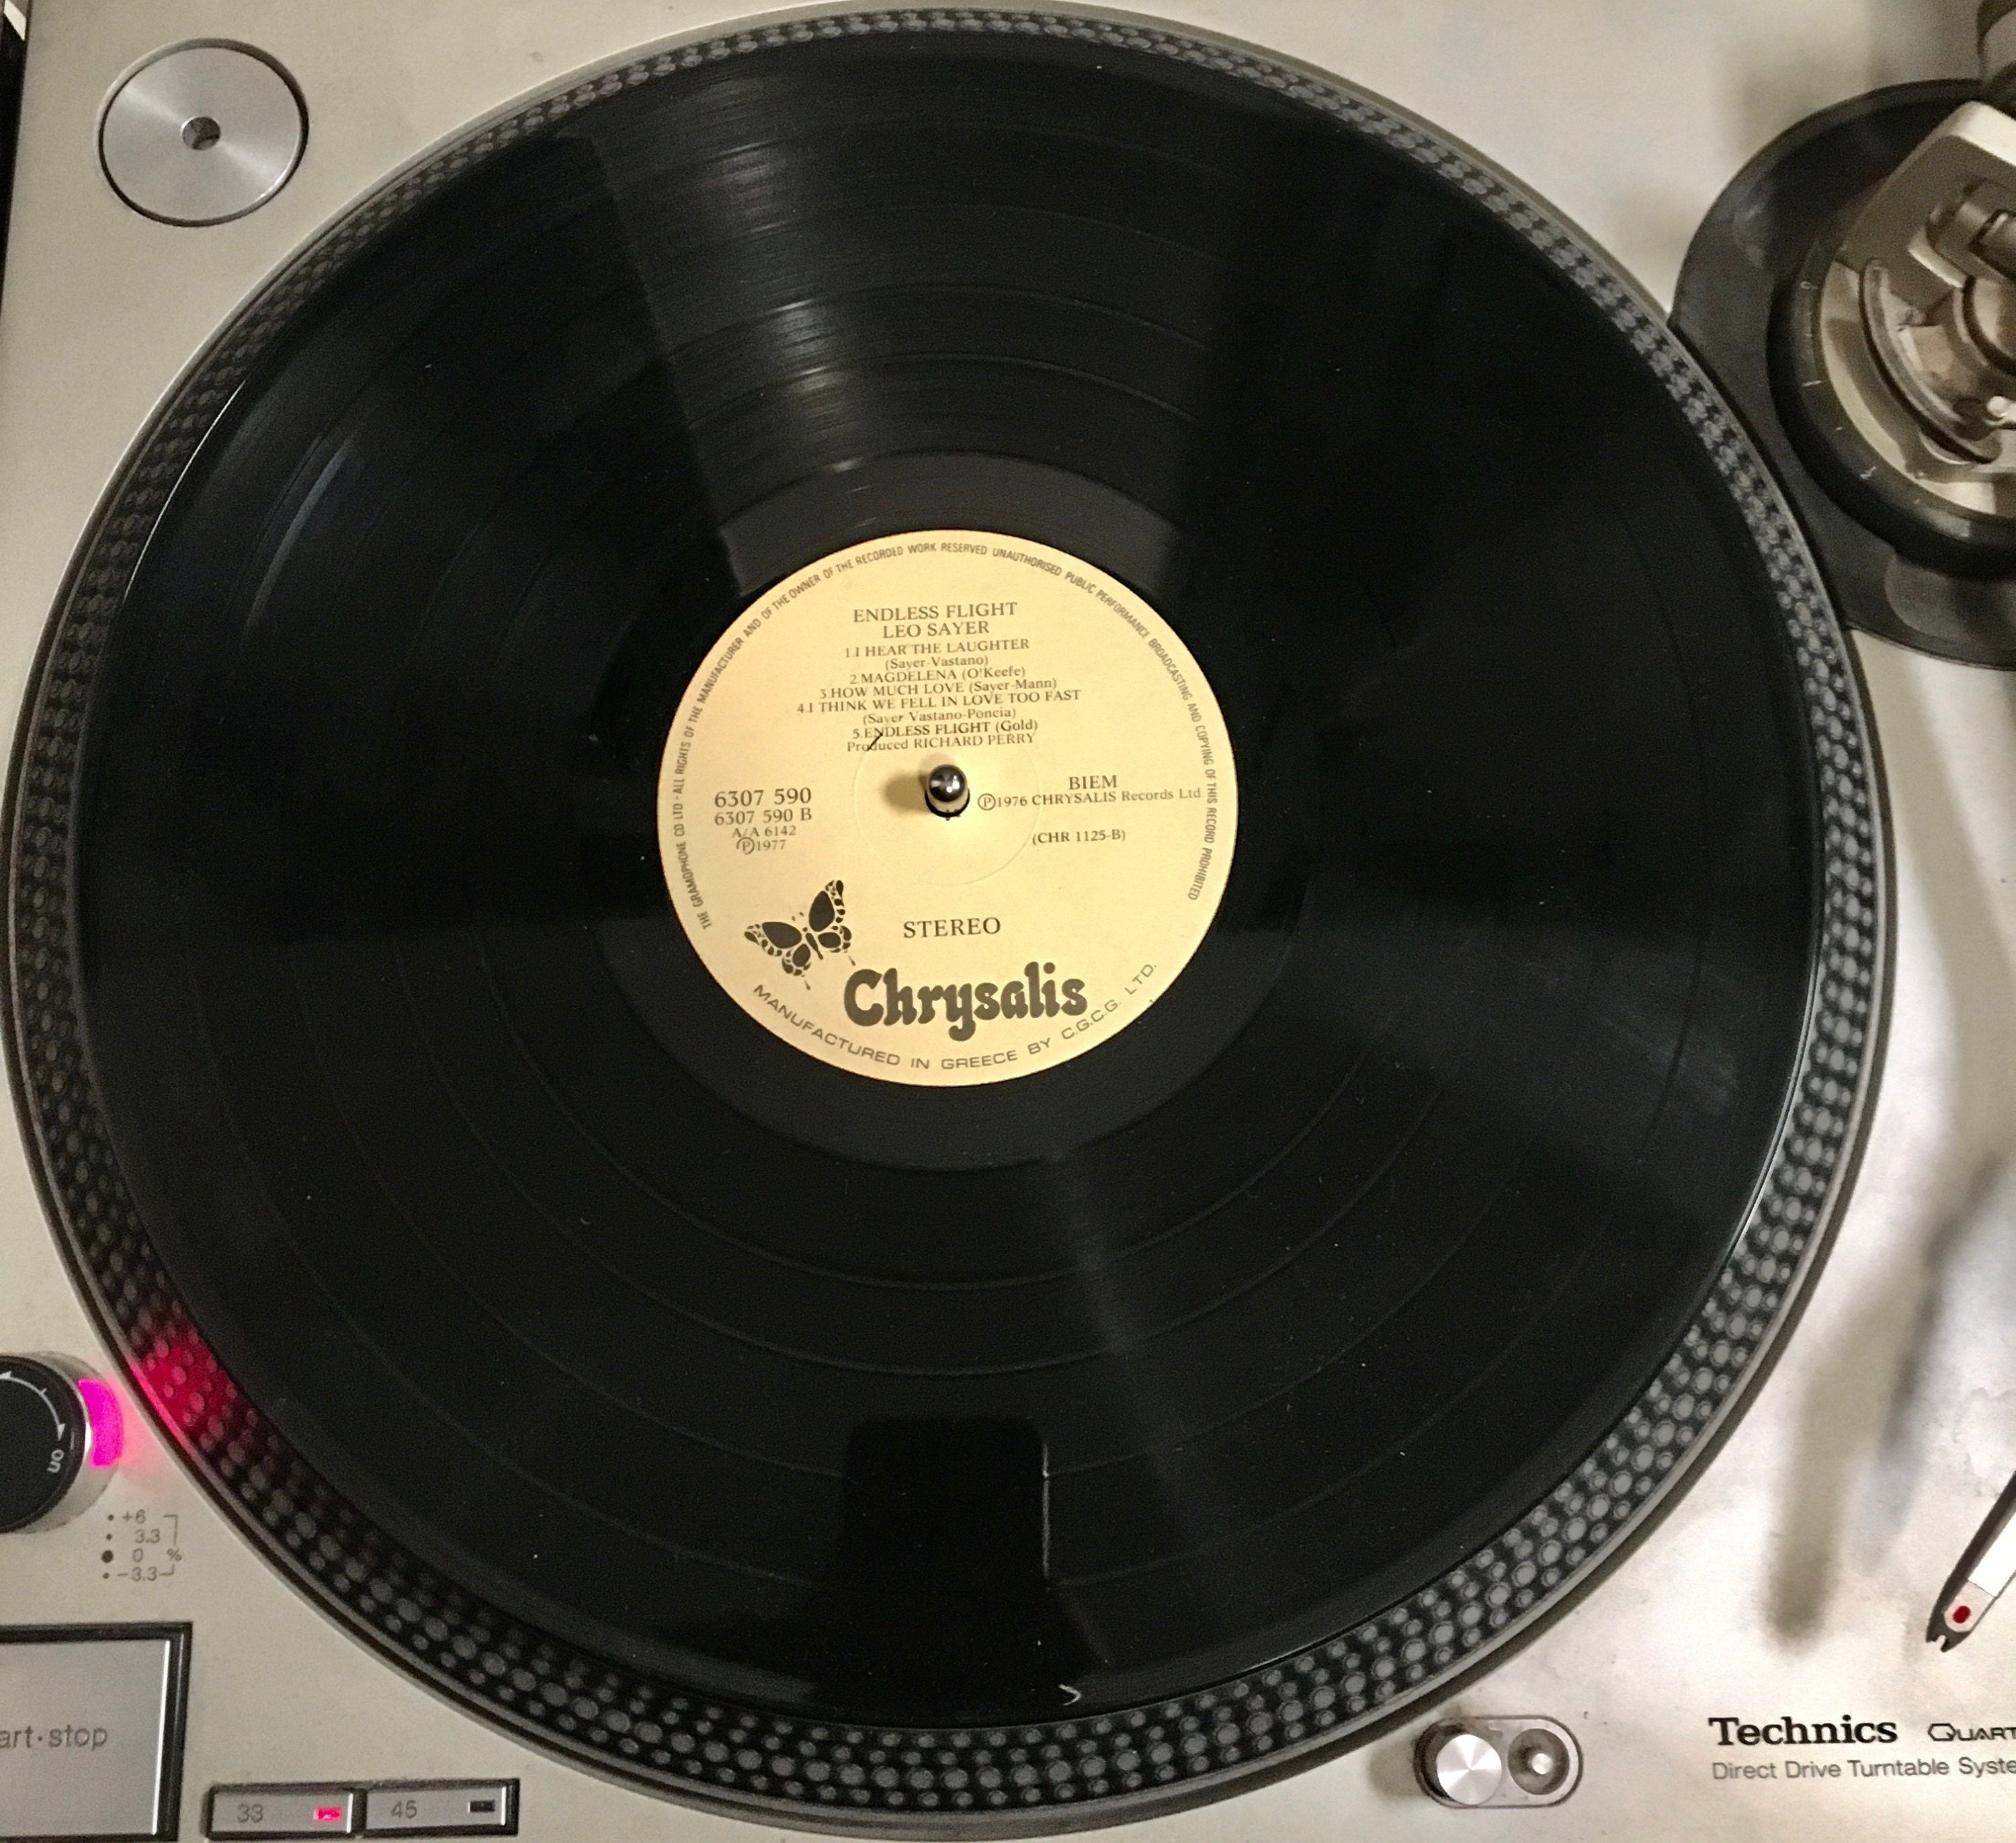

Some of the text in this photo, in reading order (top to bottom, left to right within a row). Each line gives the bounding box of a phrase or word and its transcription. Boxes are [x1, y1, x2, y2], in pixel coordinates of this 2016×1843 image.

[856, 546, 903, 566] RECORDED
[907, 542, 936, 554] WORK
[941, 542, 987, 555] RESERVED
[836, 559, 853, 573] THE
[993, 547, 1062, 577] UNAUTHORISED
[823, 567, 834, 579] OF
[1064, 571, 1097, 594] PUBLIC
[788, 574, 821, 598] OWNER
[771, 594, 790, 610] THE
[761, 606, 774, 619] OF
[853, 602, 1017, 622] ENDLESS FLIGHT
[743, 618, 761, 638] AND
[882, 621, 989, 639] LEO SAYER
[866, 645, 907, 657] HEAR
[913, 643, 941, 655] THE
[947, 639, 1030, 653] LAUGHTER
[698, 637, 745, 703] MANUFACTURER
[962, 665, 1025, 680] (O'Keefe)
[1148, 638, 1193, 700] BROADCASTING
[874, 684, 918, 696] MUCH
[924, 682, 964, 694] LOVE
[969, 678, 1057, 694] (Sayer-Mann)
[818, 700, 867, 712] THINK
[872, 698, 896, 709] WE
[901, 697, 936, 708] FELL
[941, 696, 958, 706] IN
[963, 694, 1003, 706] LOVE
[1008, 692, 1040, 703] TOO
[1045, 690, 1081, 702] FAST
[689, 705, 703, 726] THE
[1187, 703, 1202, 722] AND
[684, 726, 695, 737] OF
[935, 721, 991, 735] FLIGHT
[995, 719, 1038, 734] (Gold)
[847, 733, 1034, 751] Produced RICHARD PERRY
[1195, 725, 1214, 766] COPYING
[675, 741, 691, 774] RIGHTS
[1068, 775, 1118, 790] BIEM
[1204, 769, 1216, 780] OF
[673, 778, 685, 794] ALL
[1206, 782, 1218, 804] THIS
[714, 787, 811, 808] 6307 590
[1032, 791, 1117, 806] CHRYSALIS
[1122, 788, 1174, 802] Records
[673, 803, 683, 820] LTD
[714, 807, 812, 826] 6307 590 B
[674, 824, 685, 837] CO
[732, 825, 796, 838] A/A 6142
[1204, 807, 1217, 844] RECORD
[1032, 829, 1126, 846] (CHR 1125-B)
[676, 842, 704, 907] GRAMOPHONE
[1187, 847, 1213, 901] PROHIBITED
[698, 910, 712, 930] THE
[903, 917, 1001, 938] STEREO
[843, 961, 1088, 1042] Chrysalis
[753, 963, 1158, 1070] MANUFACTURED IN GREECE BY C.G.C.G. LTD.
[47, 1448, 65, 1473] on
[122, 1510, 146, 1524] +6
[135, 1528, 161, 1544] 3.3
[132, 1548, 183, 1563] 0 %
[1708, 1715, 1898, 1746] Technics
[1712, 1761, 1776, 1780] Direct
[1785, 1760, 1841, 1778] Drive
[1847, 1758, 1949, 1778] Turntable
[237, 1804, 263, 1823] 33
[391, 1800, 418, 1819] 45
